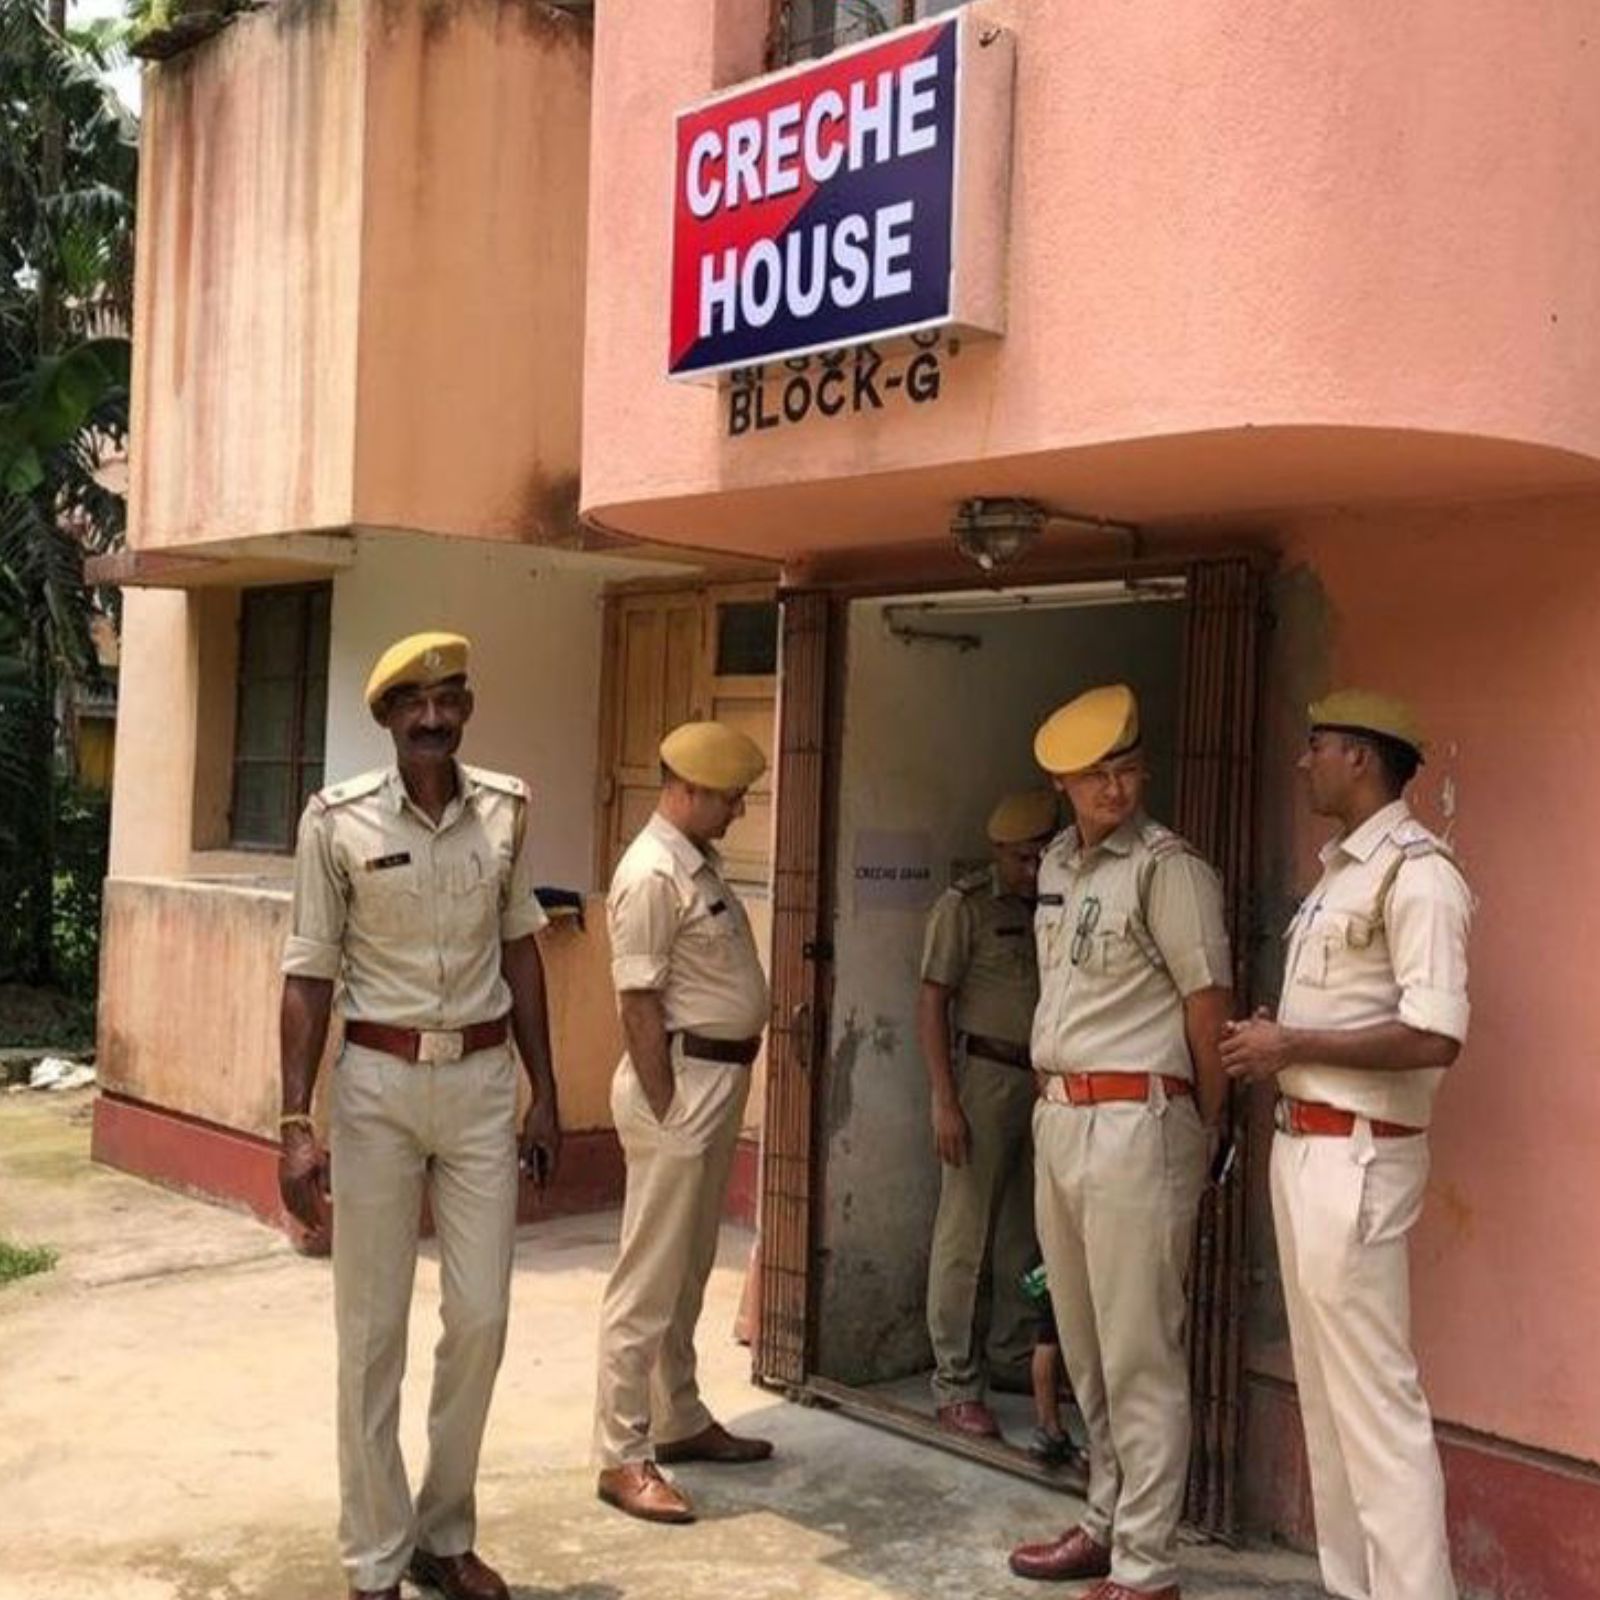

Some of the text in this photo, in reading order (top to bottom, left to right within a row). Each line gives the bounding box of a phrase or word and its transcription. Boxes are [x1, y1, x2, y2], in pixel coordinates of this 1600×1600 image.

[686, 55, 938, 217] CRECHE
[699, 201, 914, 338] HOUSE
[729, 352, 940, 436] BLOCK-G
